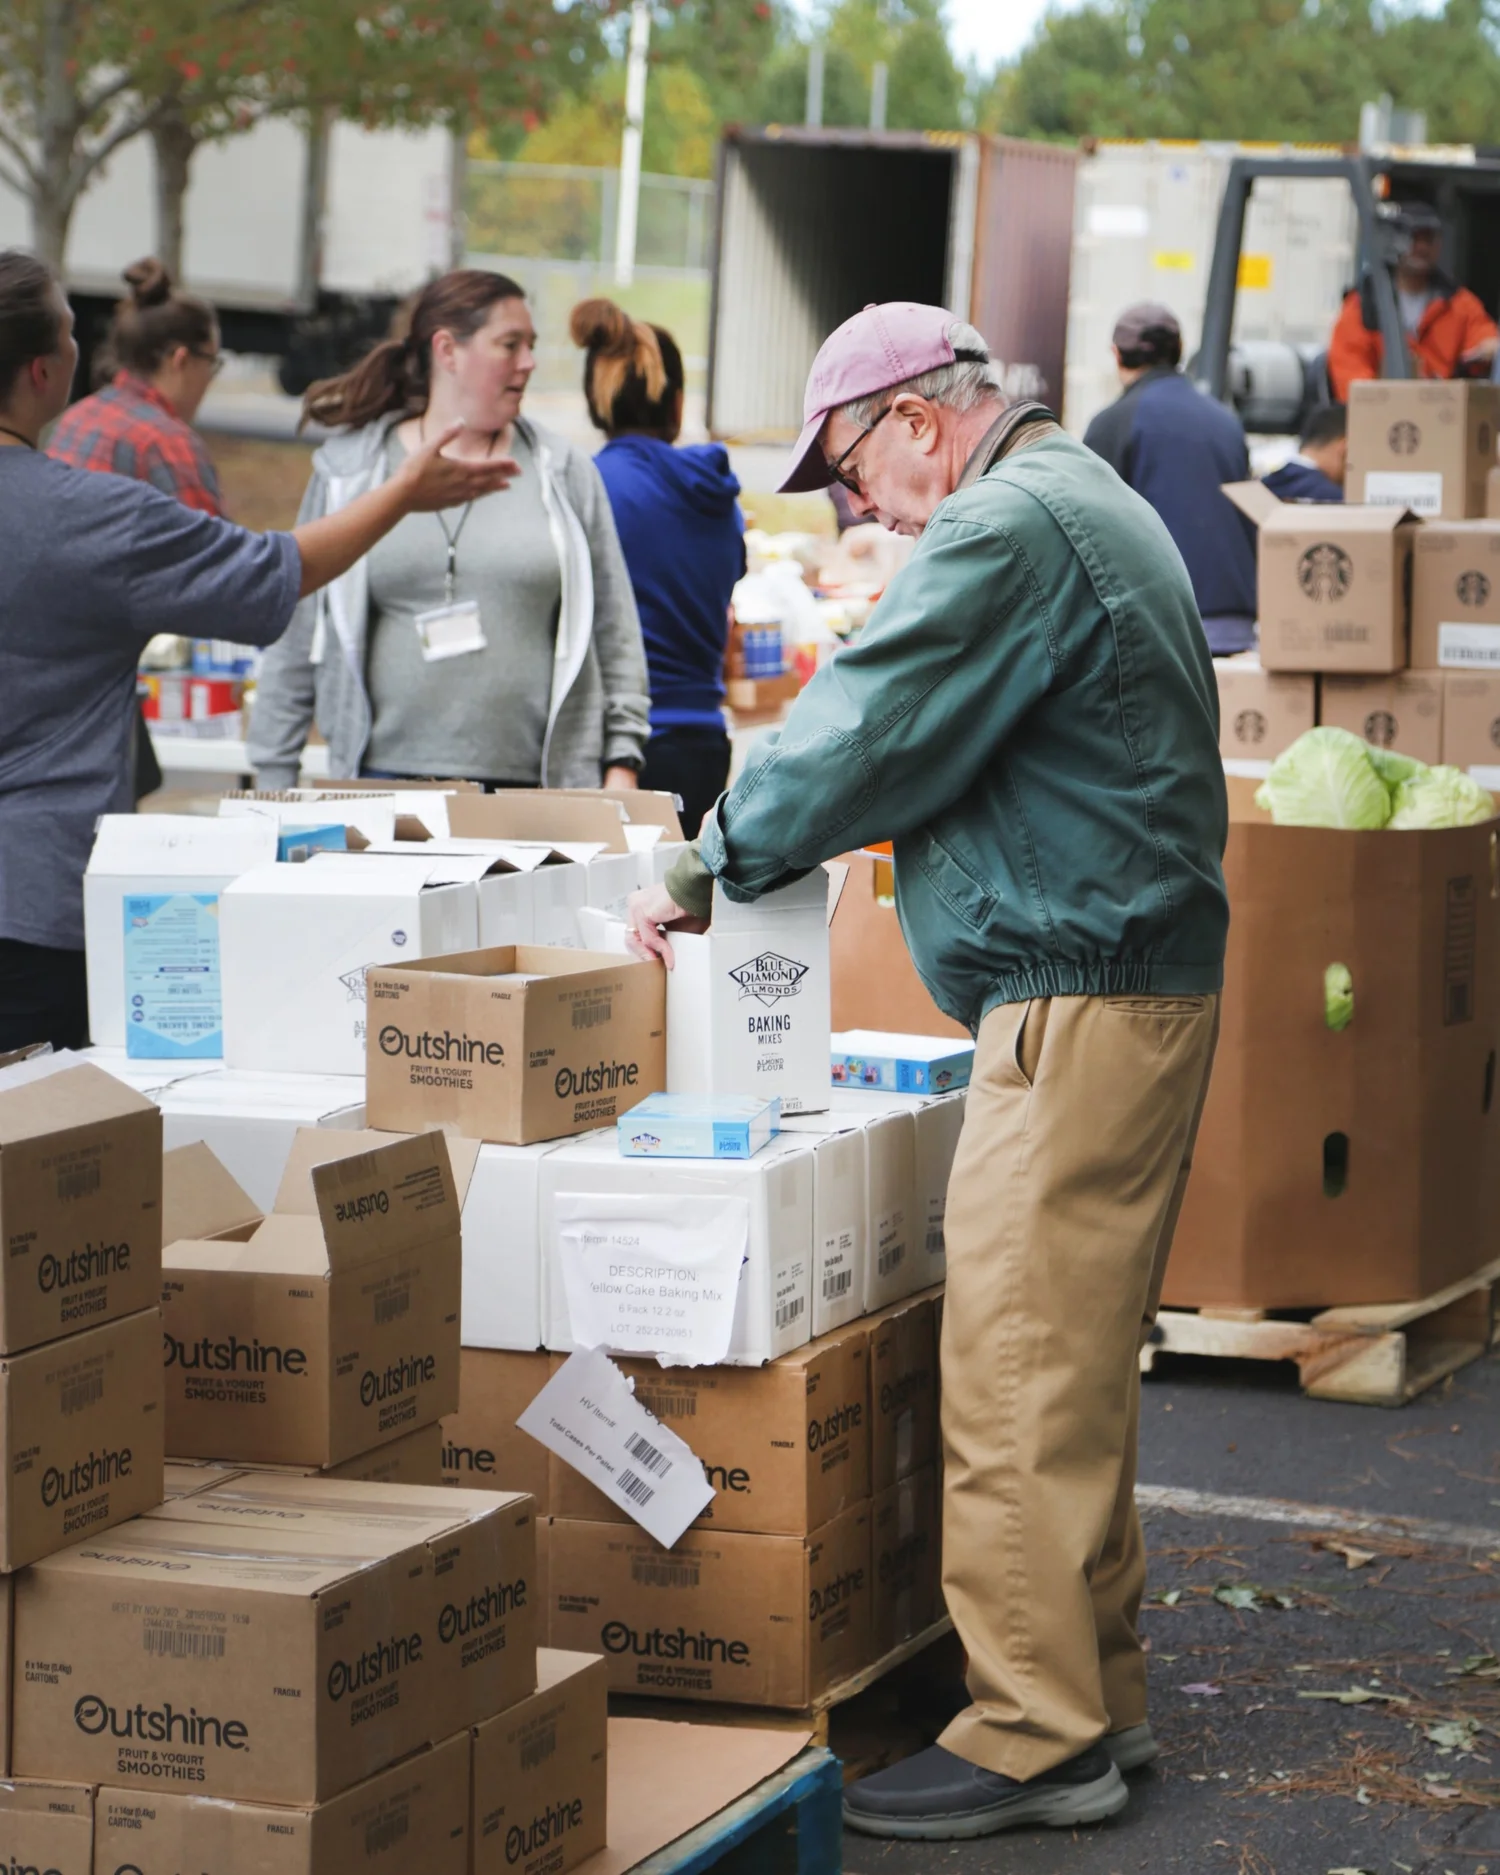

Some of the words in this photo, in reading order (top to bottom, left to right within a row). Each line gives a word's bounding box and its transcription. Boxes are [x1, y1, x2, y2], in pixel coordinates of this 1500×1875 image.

[755, 959, 784, 972] BLUE
[740, 967, 800, 984] DIAMOND
[744, 985, 797, 995] ALMONDS
[749, 1014, 791, 1033] BAKING
[758, 1034, 782, 1045] MIXES
[757, 1058, 784, 1066] ALMOND
[757, 1064, 784, 1072] FLOUR
[410, 1065, 433, 1075] FRUIT
[434, 1067, 440, 1075] &
[441, 1068, 472, 1077] YOGURT
[410, 1075, 473, 1089] SMOOTHIES
[573, 1105, 616, 1123] SMOOTHIES
[612, 1236, 640, 1246] 14524
[288, 1289, 314, 1298] FRAGILE
[625, 1284, 655, 1296] Cake
[659, 1285, 699, 1302] Baking
[702, 1289, 723, 1301] Mix
[61, 1298, 107, 1322] SMOOTHIES
[619, 1305, 625, 1313] 6
[674, 1309, 686, 1317] oz
[610, 1324, 630, 1333] LOT
[186, 1377, 213, 1387] FRUIT
[215, 1378, 223, 1388] &
[226, 1379, 265, 1390] YOGURT
[185, 1388, 266, 1404] SMOOTHIES
[579, 1396, 595, 1410] HV
[549, 1417, 565, 1434] Total
[564, 1427, 584, 1449] Cases
[584, 1445, 597, 1459] Per
[64, 1505, 81, 1519] FRUIT
[63, 1504, 110, 1536] SMOOTHIES
[144, 1605, 160, 1616] NOV
[462, 1636, 506, 1668] SMOOTHIES
[25, 1660, 30, 1669] 6
[36, 1662, 50, 1672] 14oz
[51, 1663, 72, 1675] (0.4kg)
[25, 1671, 59, 1684] CARTONS
[637, 1673, 712, 1690] SMOOTHIES
[273, 1687, 301, 1698] FRAGILE
[351, 1692, 399, 1727] SMOOTHIES
[118, 1748, 149, 1761] FRUIT
[152, 1752, 158, 1761] &
[160, 1753, 205, 1766] YOGURT
[117, 1759, 206, 1781] SMOOTHIES
[49, 1803, 76, 1814] FRAGILE
[108, 1805, 113, 1814] 6
[134, 1807, 156, 1820] (0.4kg)
[108, 1816, 142, 1829] CARTONS
[267, 1824, 295, 1835] FRAGILE
